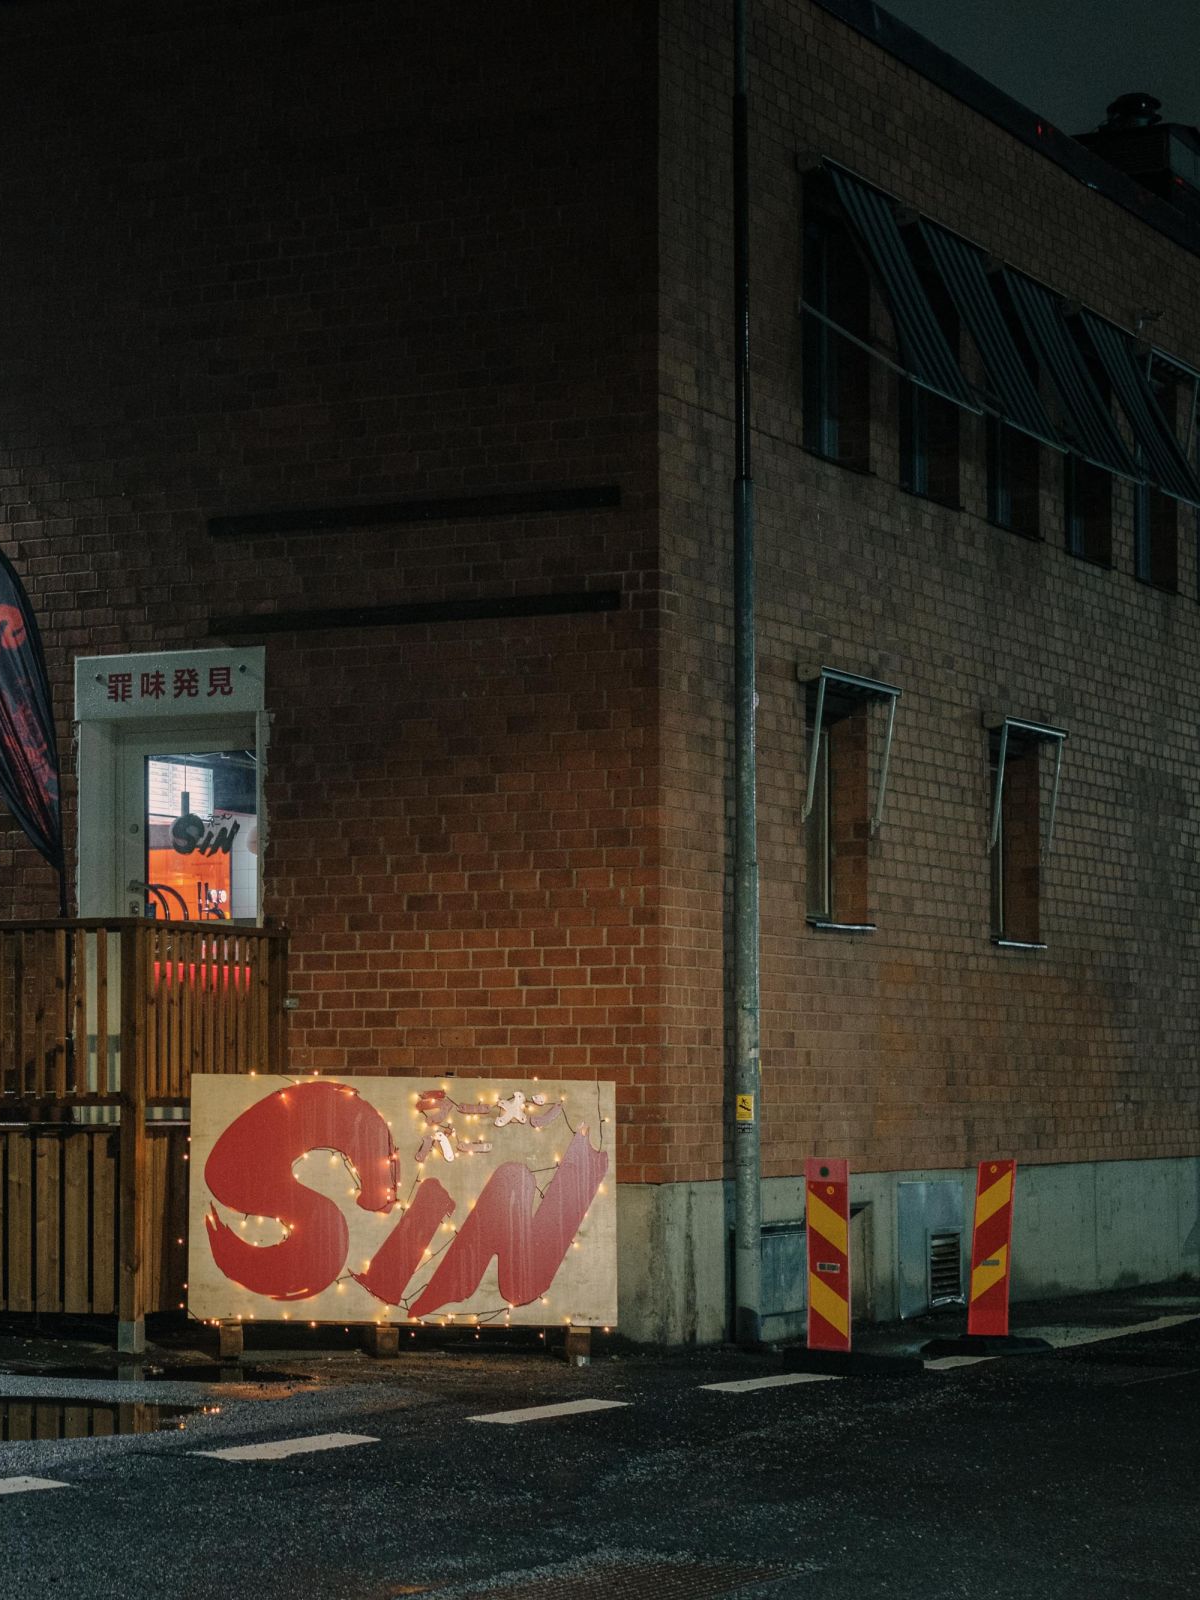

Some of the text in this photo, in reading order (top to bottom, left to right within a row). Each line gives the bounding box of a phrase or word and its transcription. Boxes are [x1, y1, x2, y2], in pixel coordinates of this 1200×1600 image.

[107, 666, 233, 702] 罪味発見
[415, 1090, 562, 1128] ラーメン
